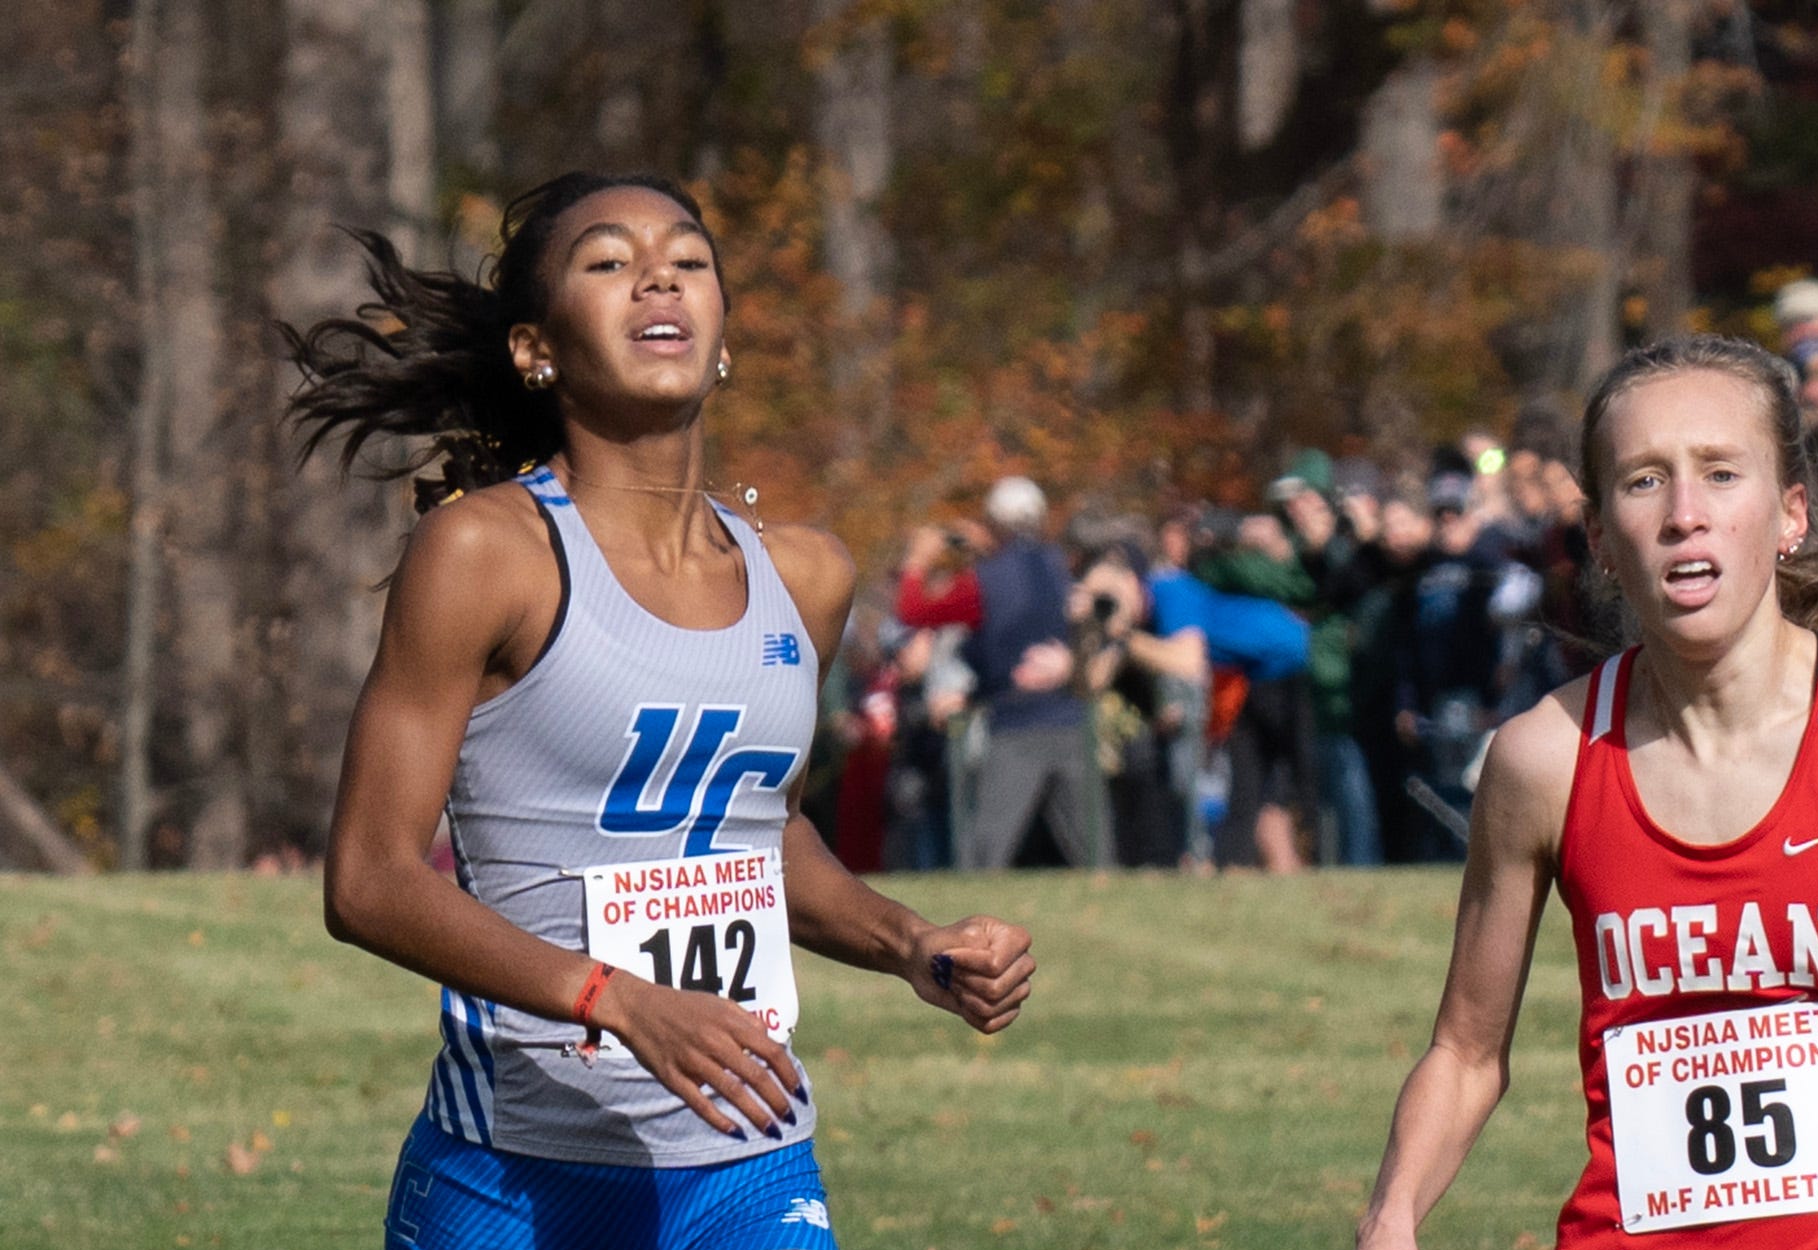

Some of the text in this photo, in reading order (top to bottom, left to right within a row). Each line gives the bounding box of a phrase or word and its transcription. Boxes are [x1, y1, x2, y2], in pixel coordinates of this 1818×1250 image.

[595, 703, 801, 858] UC
[614, 856, 766, 894] NJSIAA MEET
[603, 885, 776, 925] OF CHAMPIONS
[639, 919, 756, 1003] 142
[1636, 1019, 1739, 1055] NJSIAA
[1625, 1062, 1662, 1088] OF
[1685, 1078, 1796, 1175] 85
[1647, 1188, 1693, 1217] M-F
